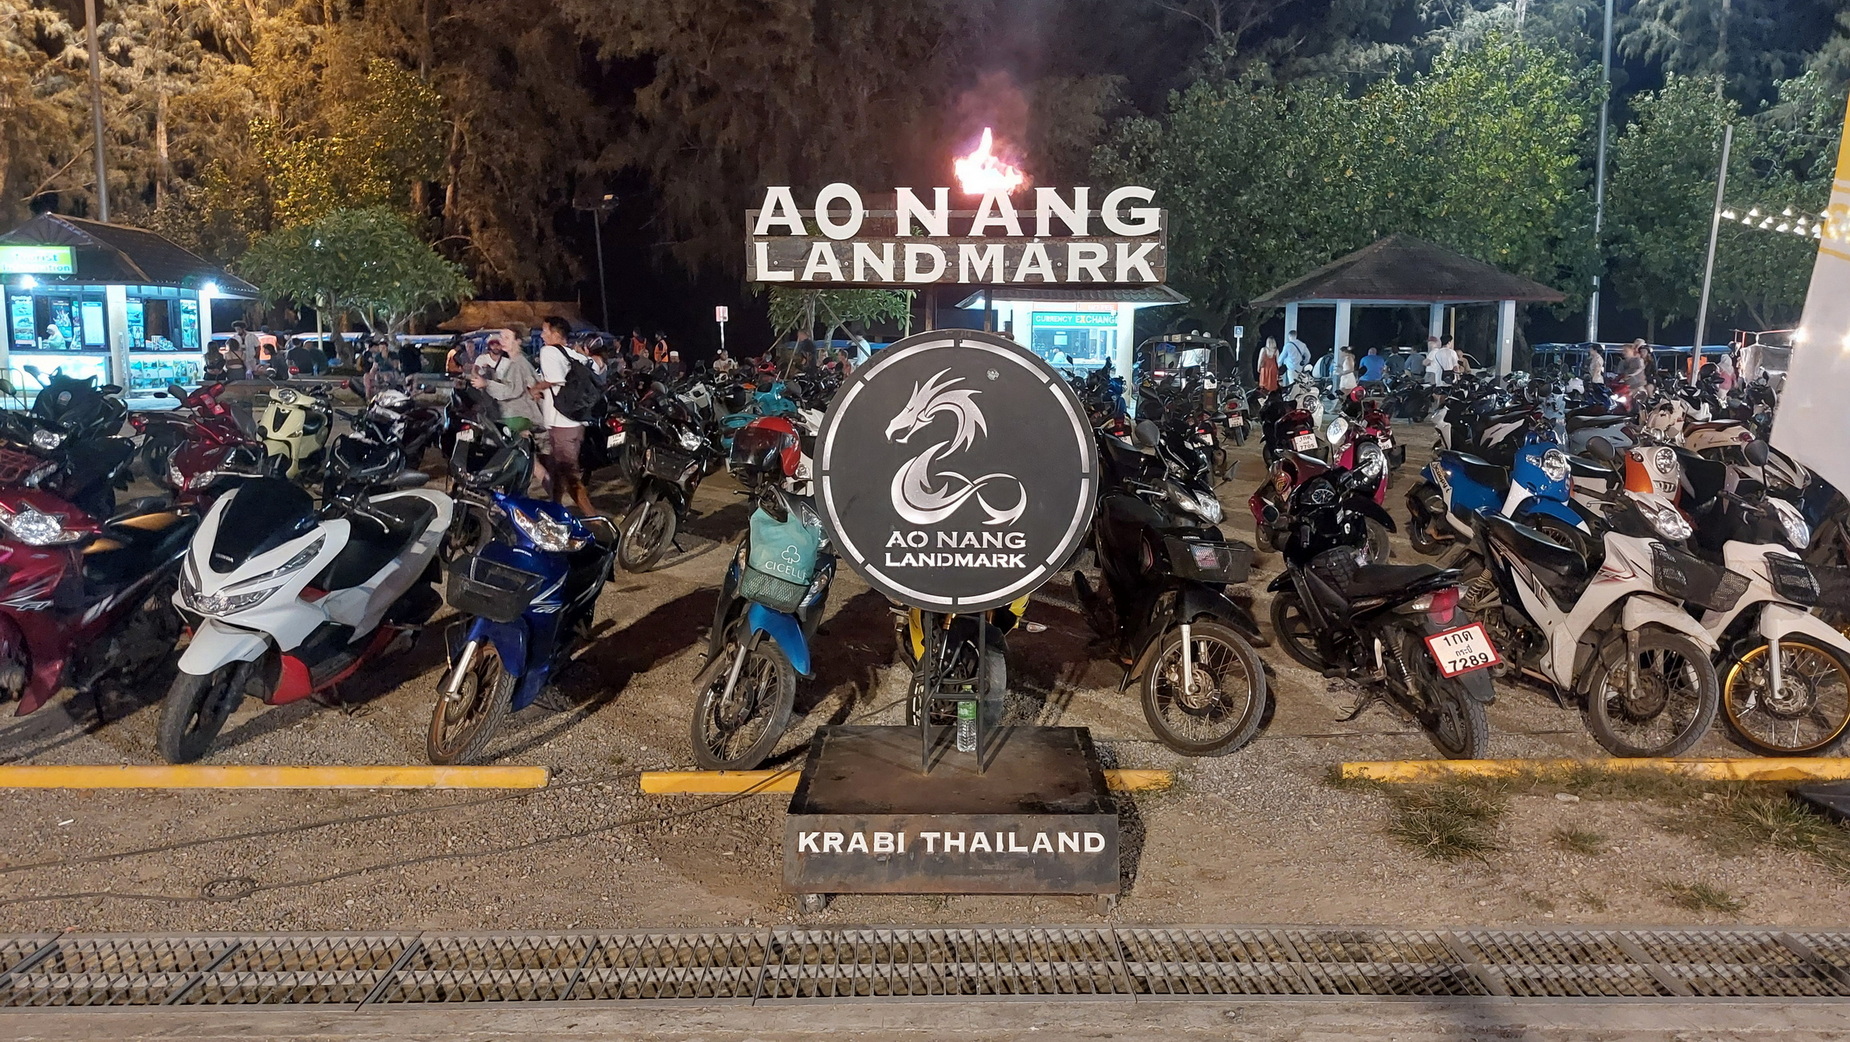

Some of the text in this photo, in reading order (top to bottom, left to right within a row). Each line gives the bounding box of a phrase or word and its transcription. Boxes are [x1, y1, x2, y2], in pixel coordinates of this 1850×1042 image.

[753, 182, 1162, 240] AO NANG
[754, 242, 1161, 284] LANDMARK
[1075, 315, 1118, 324] EXCHANG
[885, 530, 1027, 549] AO NANG
[884, 552, 1027, 568] LANDMARK
[1443, 630, 1474, 647] 1กด
[1448, 652, 1489, 672] 7289
[797, 831, 1106, 854] KRABI THAILAND
